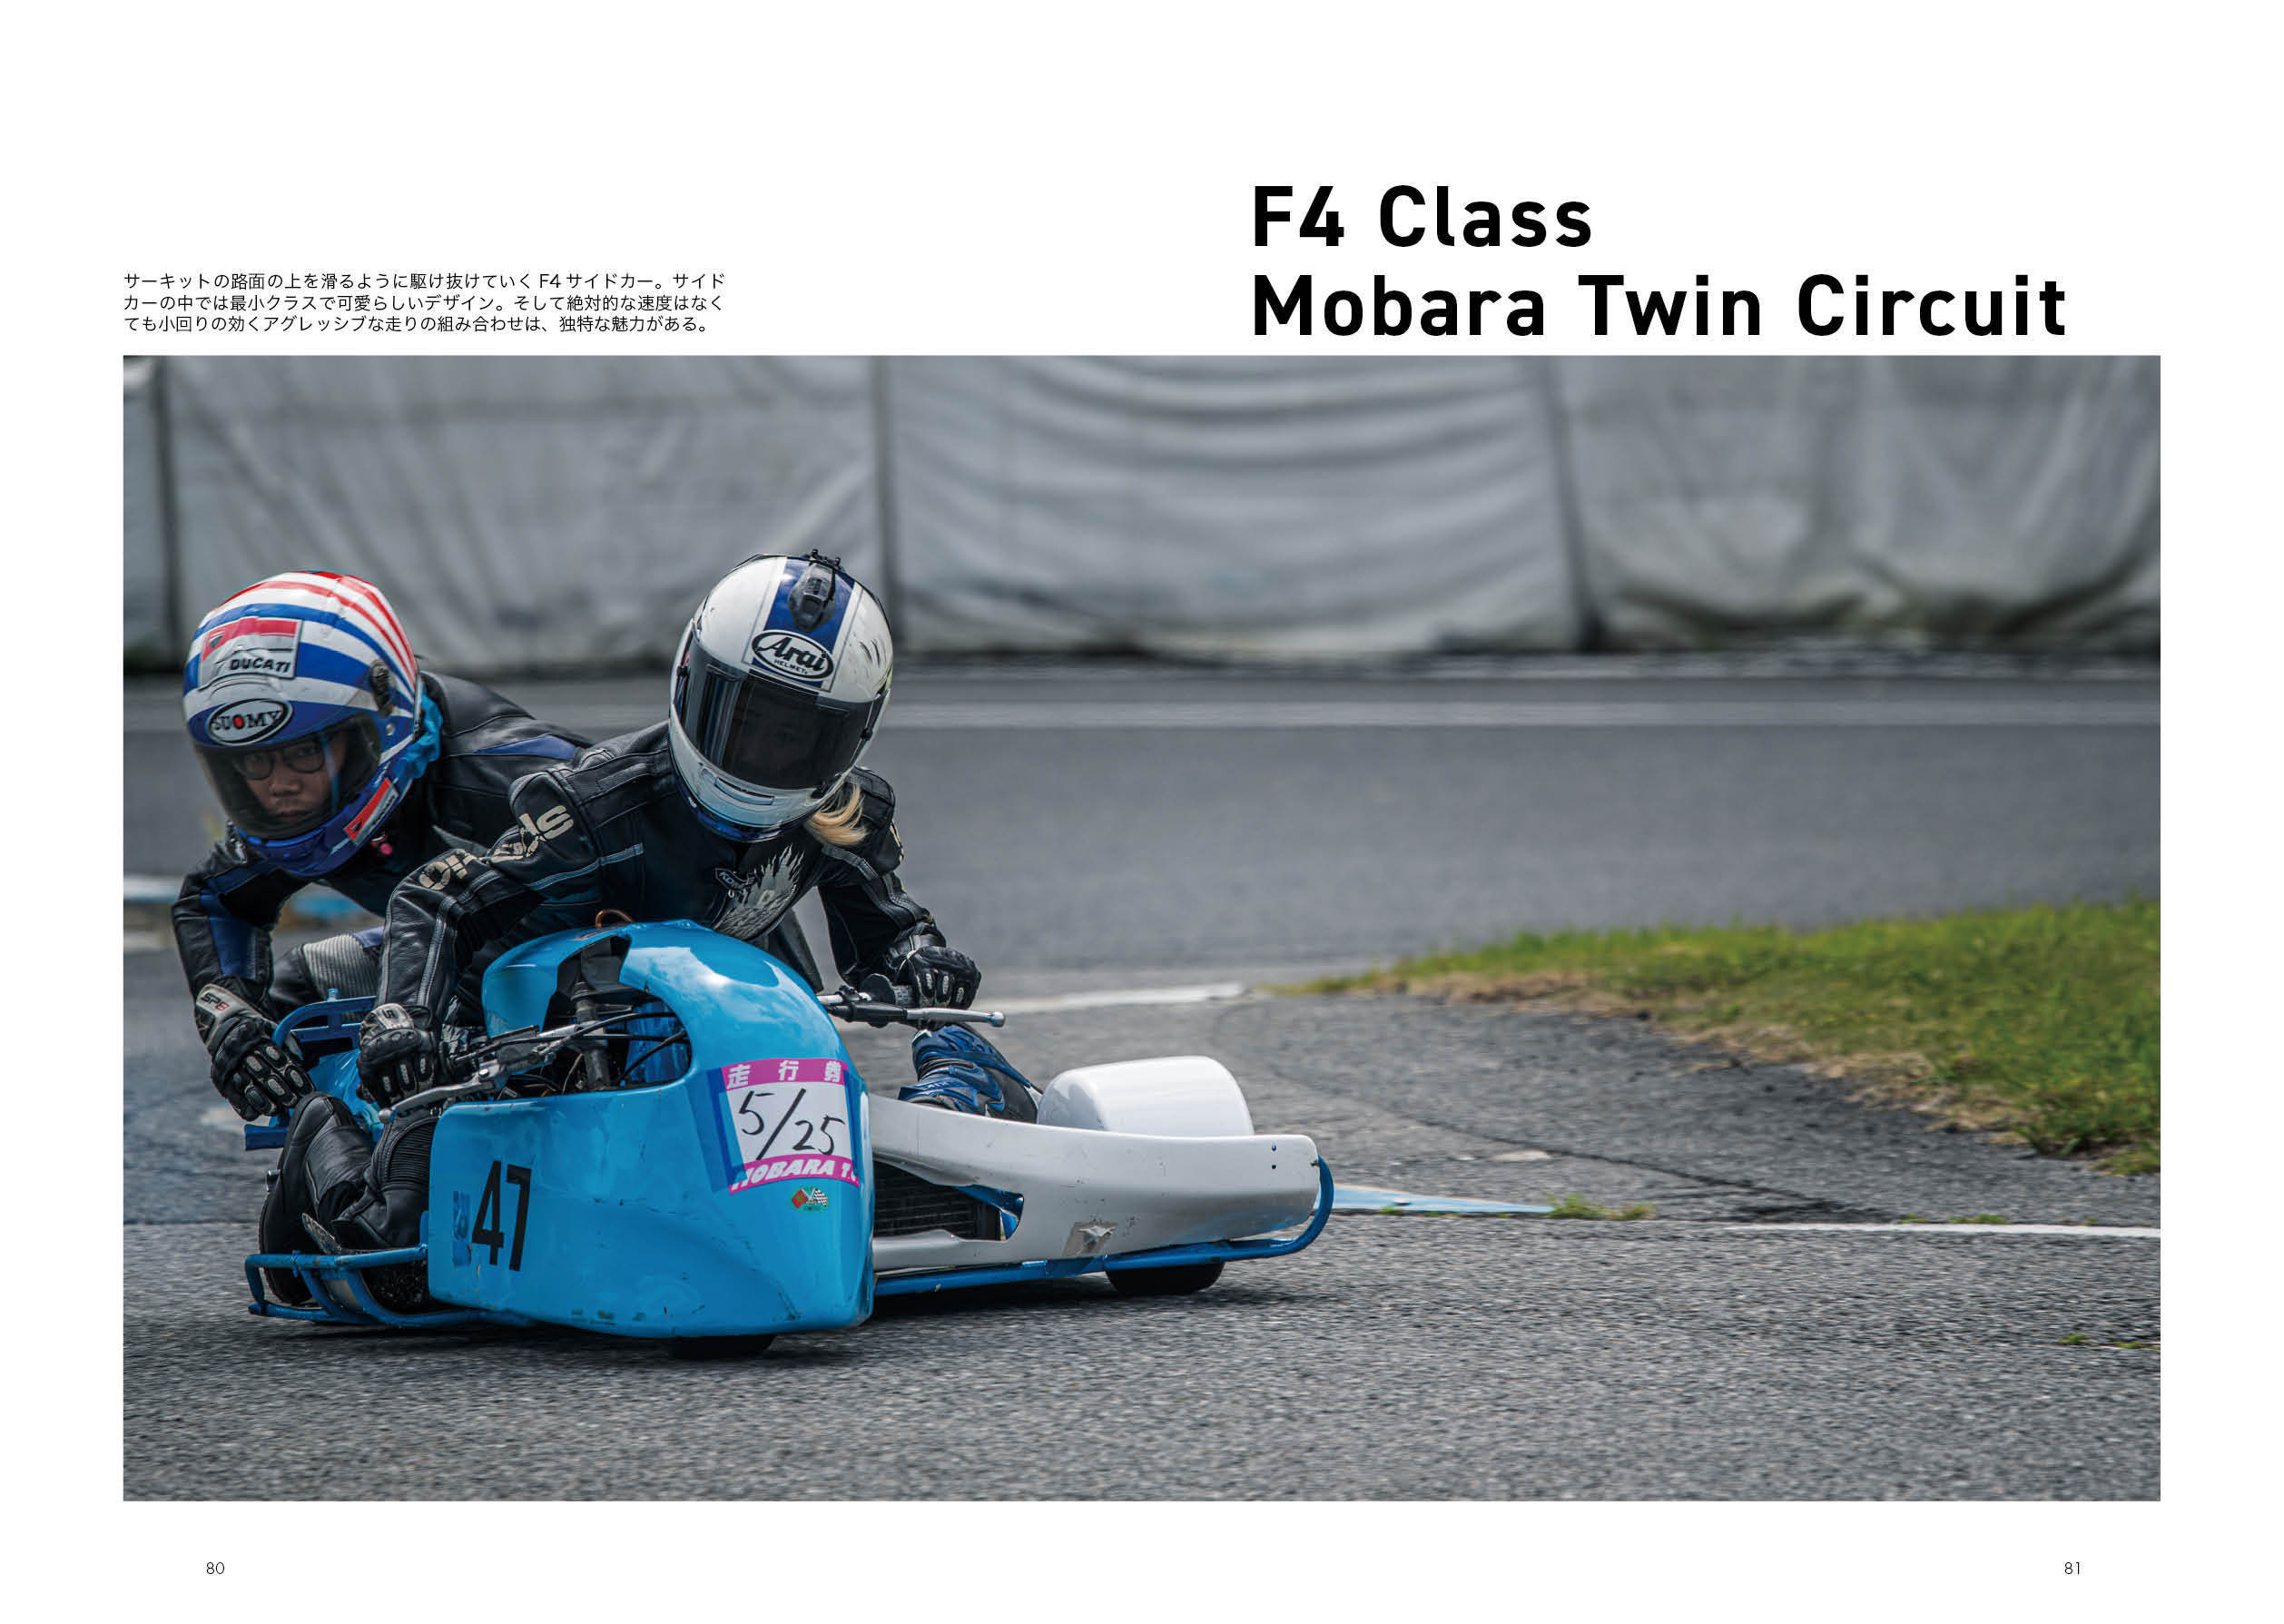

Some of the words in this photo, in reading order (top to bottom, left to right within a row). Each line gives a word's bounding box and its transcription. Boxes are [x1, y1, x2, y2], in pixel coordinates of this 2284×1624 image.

[231, 657, 290, 673] DUCATI
[757, 637, 825, 671] Arai
[211, 710, 281, 730] SUOMY
[738, 1088, 845, 1161] 5/25
[472, 1160, 532, 1271] 47
